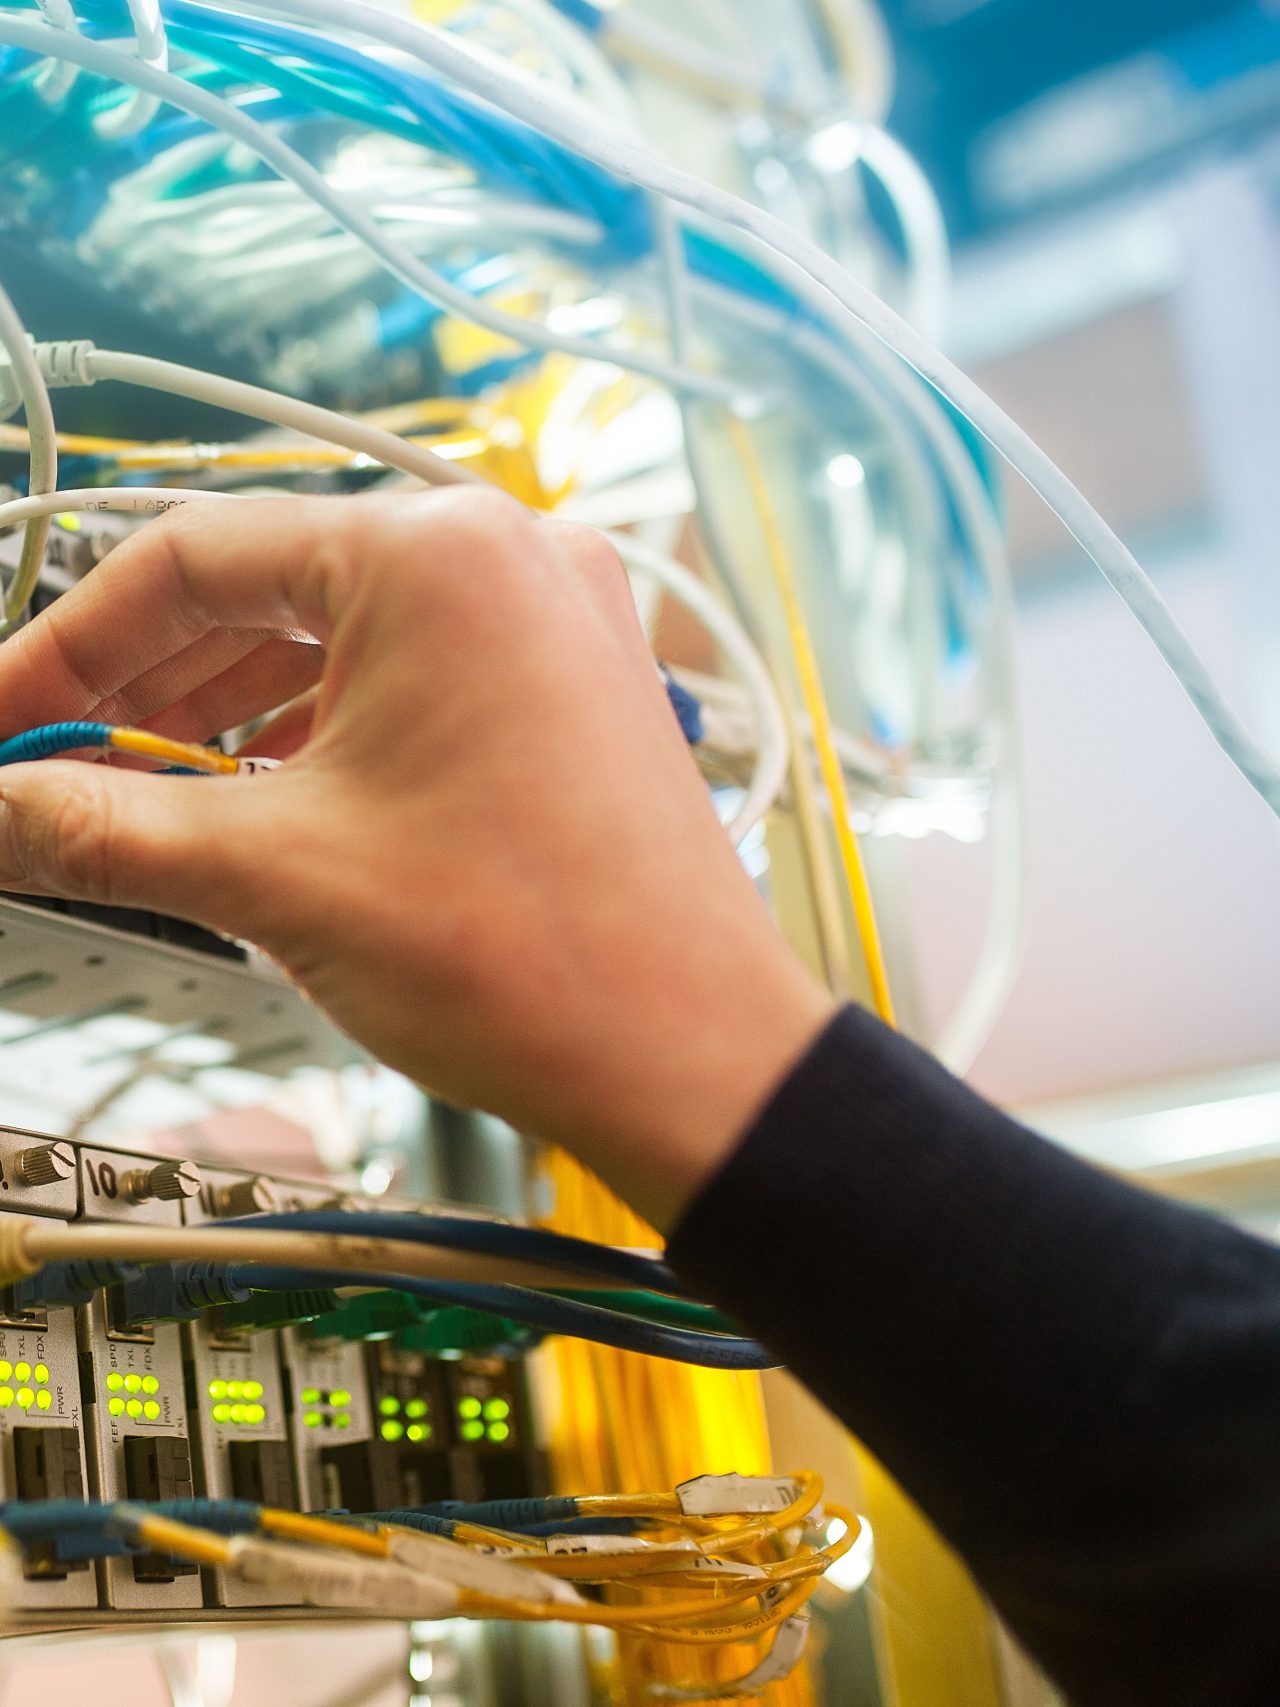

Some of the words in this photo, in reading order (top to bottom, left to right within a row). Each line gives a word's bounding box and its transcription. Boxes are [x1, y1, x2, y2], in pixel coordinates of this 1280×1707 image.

[85, 1158, 118, 1199] 10
[18, 1335, 26, 1358] TXL
[36, 1335, 45, 1360] FDX
[108, 1343, 118, 1368] SPD
[56, 1386, 66, 1415] PWR
[71, 1406, 79, 1429] FXL
[110, 1420, 119, 1443] FEF
